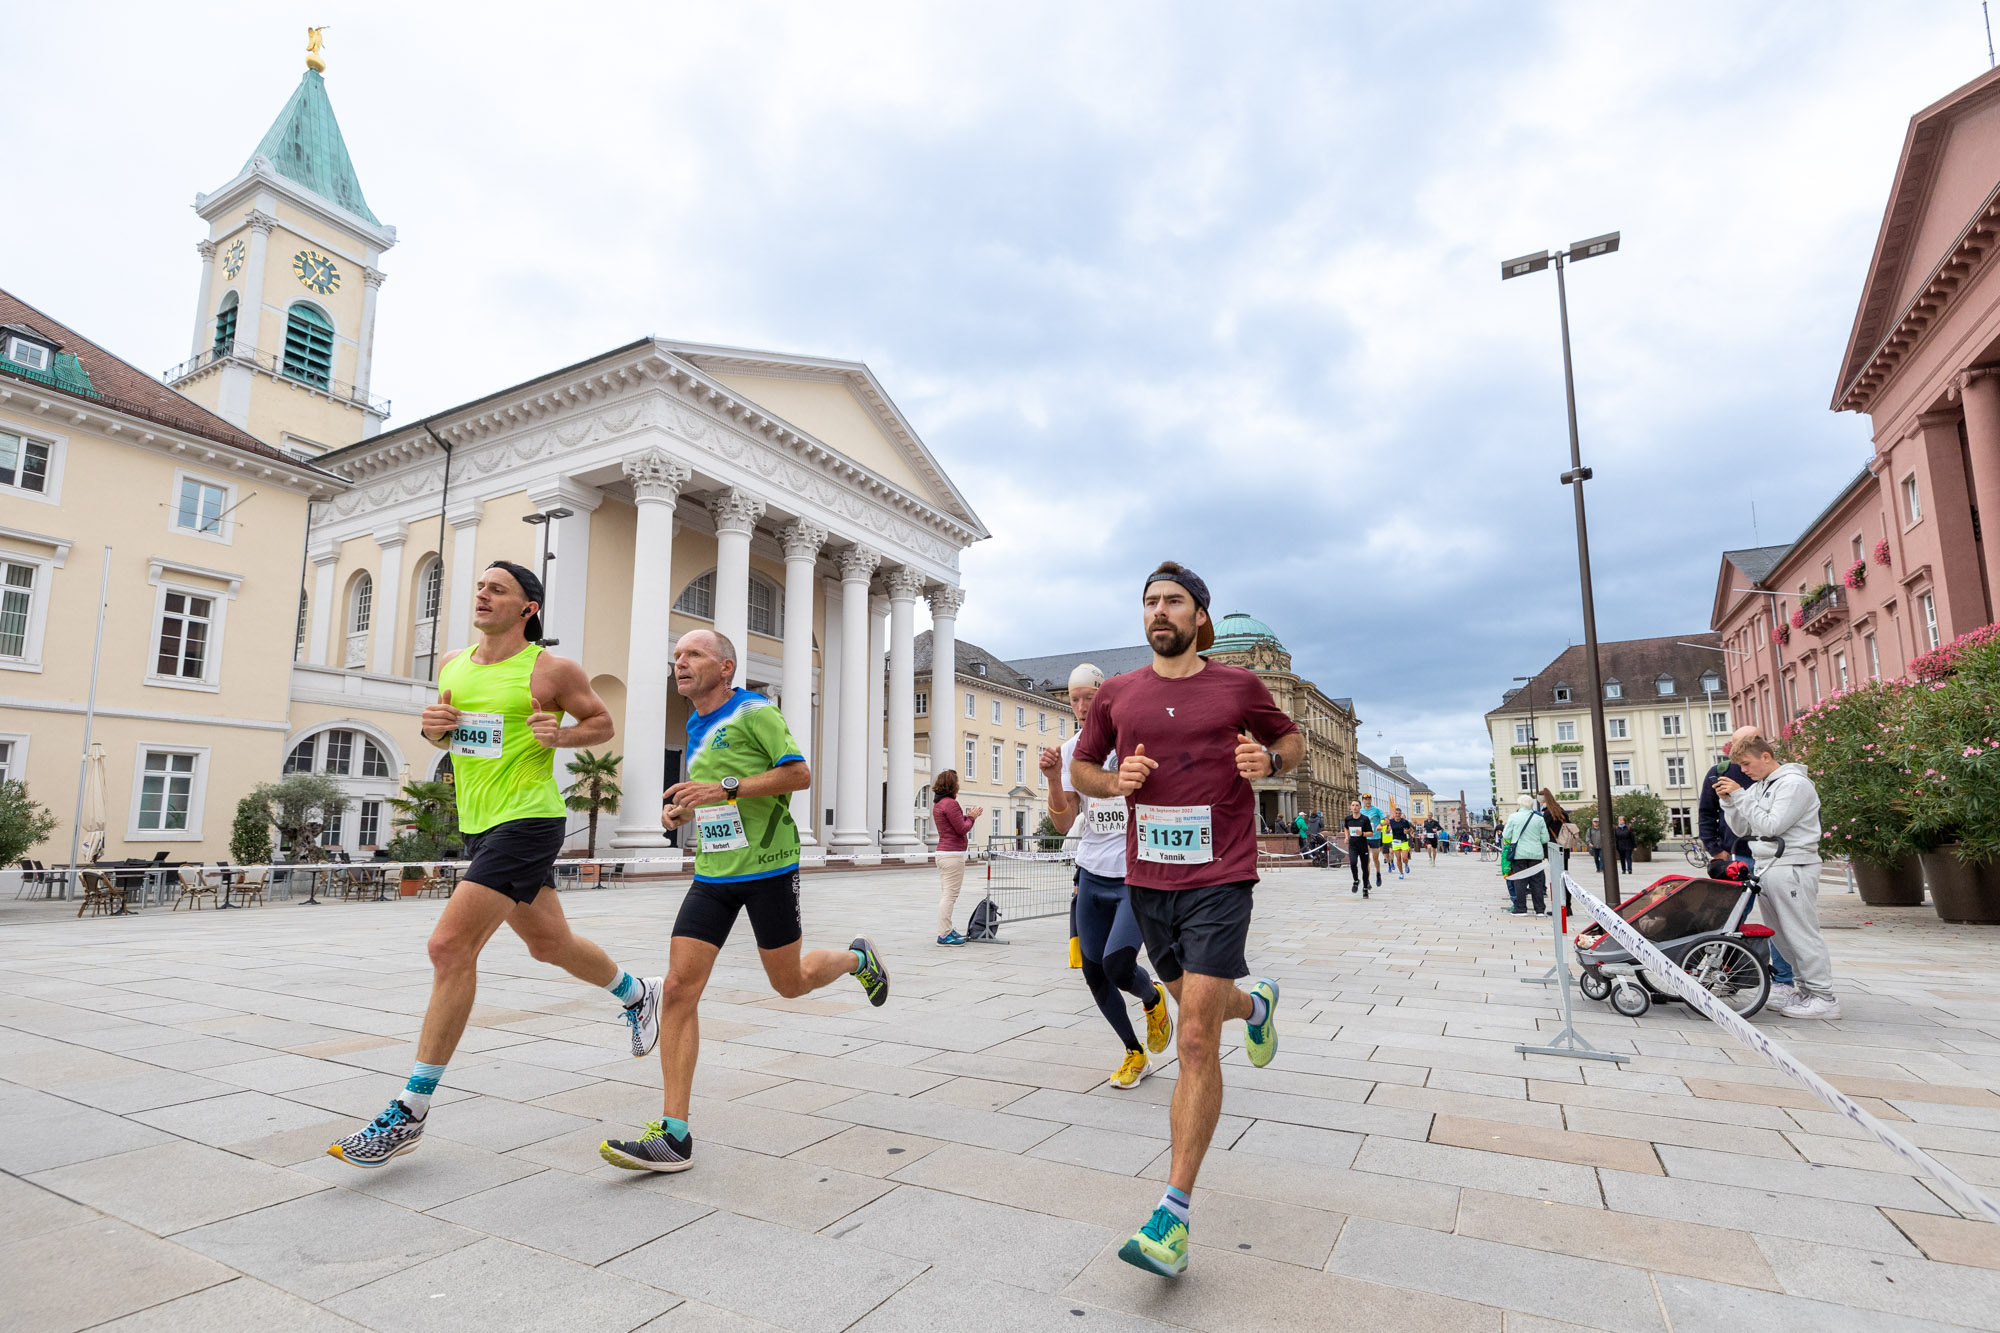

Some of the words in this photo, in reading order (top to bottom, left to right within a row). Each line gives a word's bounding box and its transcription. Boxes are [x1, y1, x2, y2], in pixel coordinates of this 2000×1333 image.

[454, 729, 487, 744] 3649
[1097, 811, 1125, 822] 9306
[704, 824, 732, 839] 3432
[1151, 828, 1194, 846] 1137
[758, 848, 800, 865] Karlsru
[1159, 852, 1186, 861] Yannik
